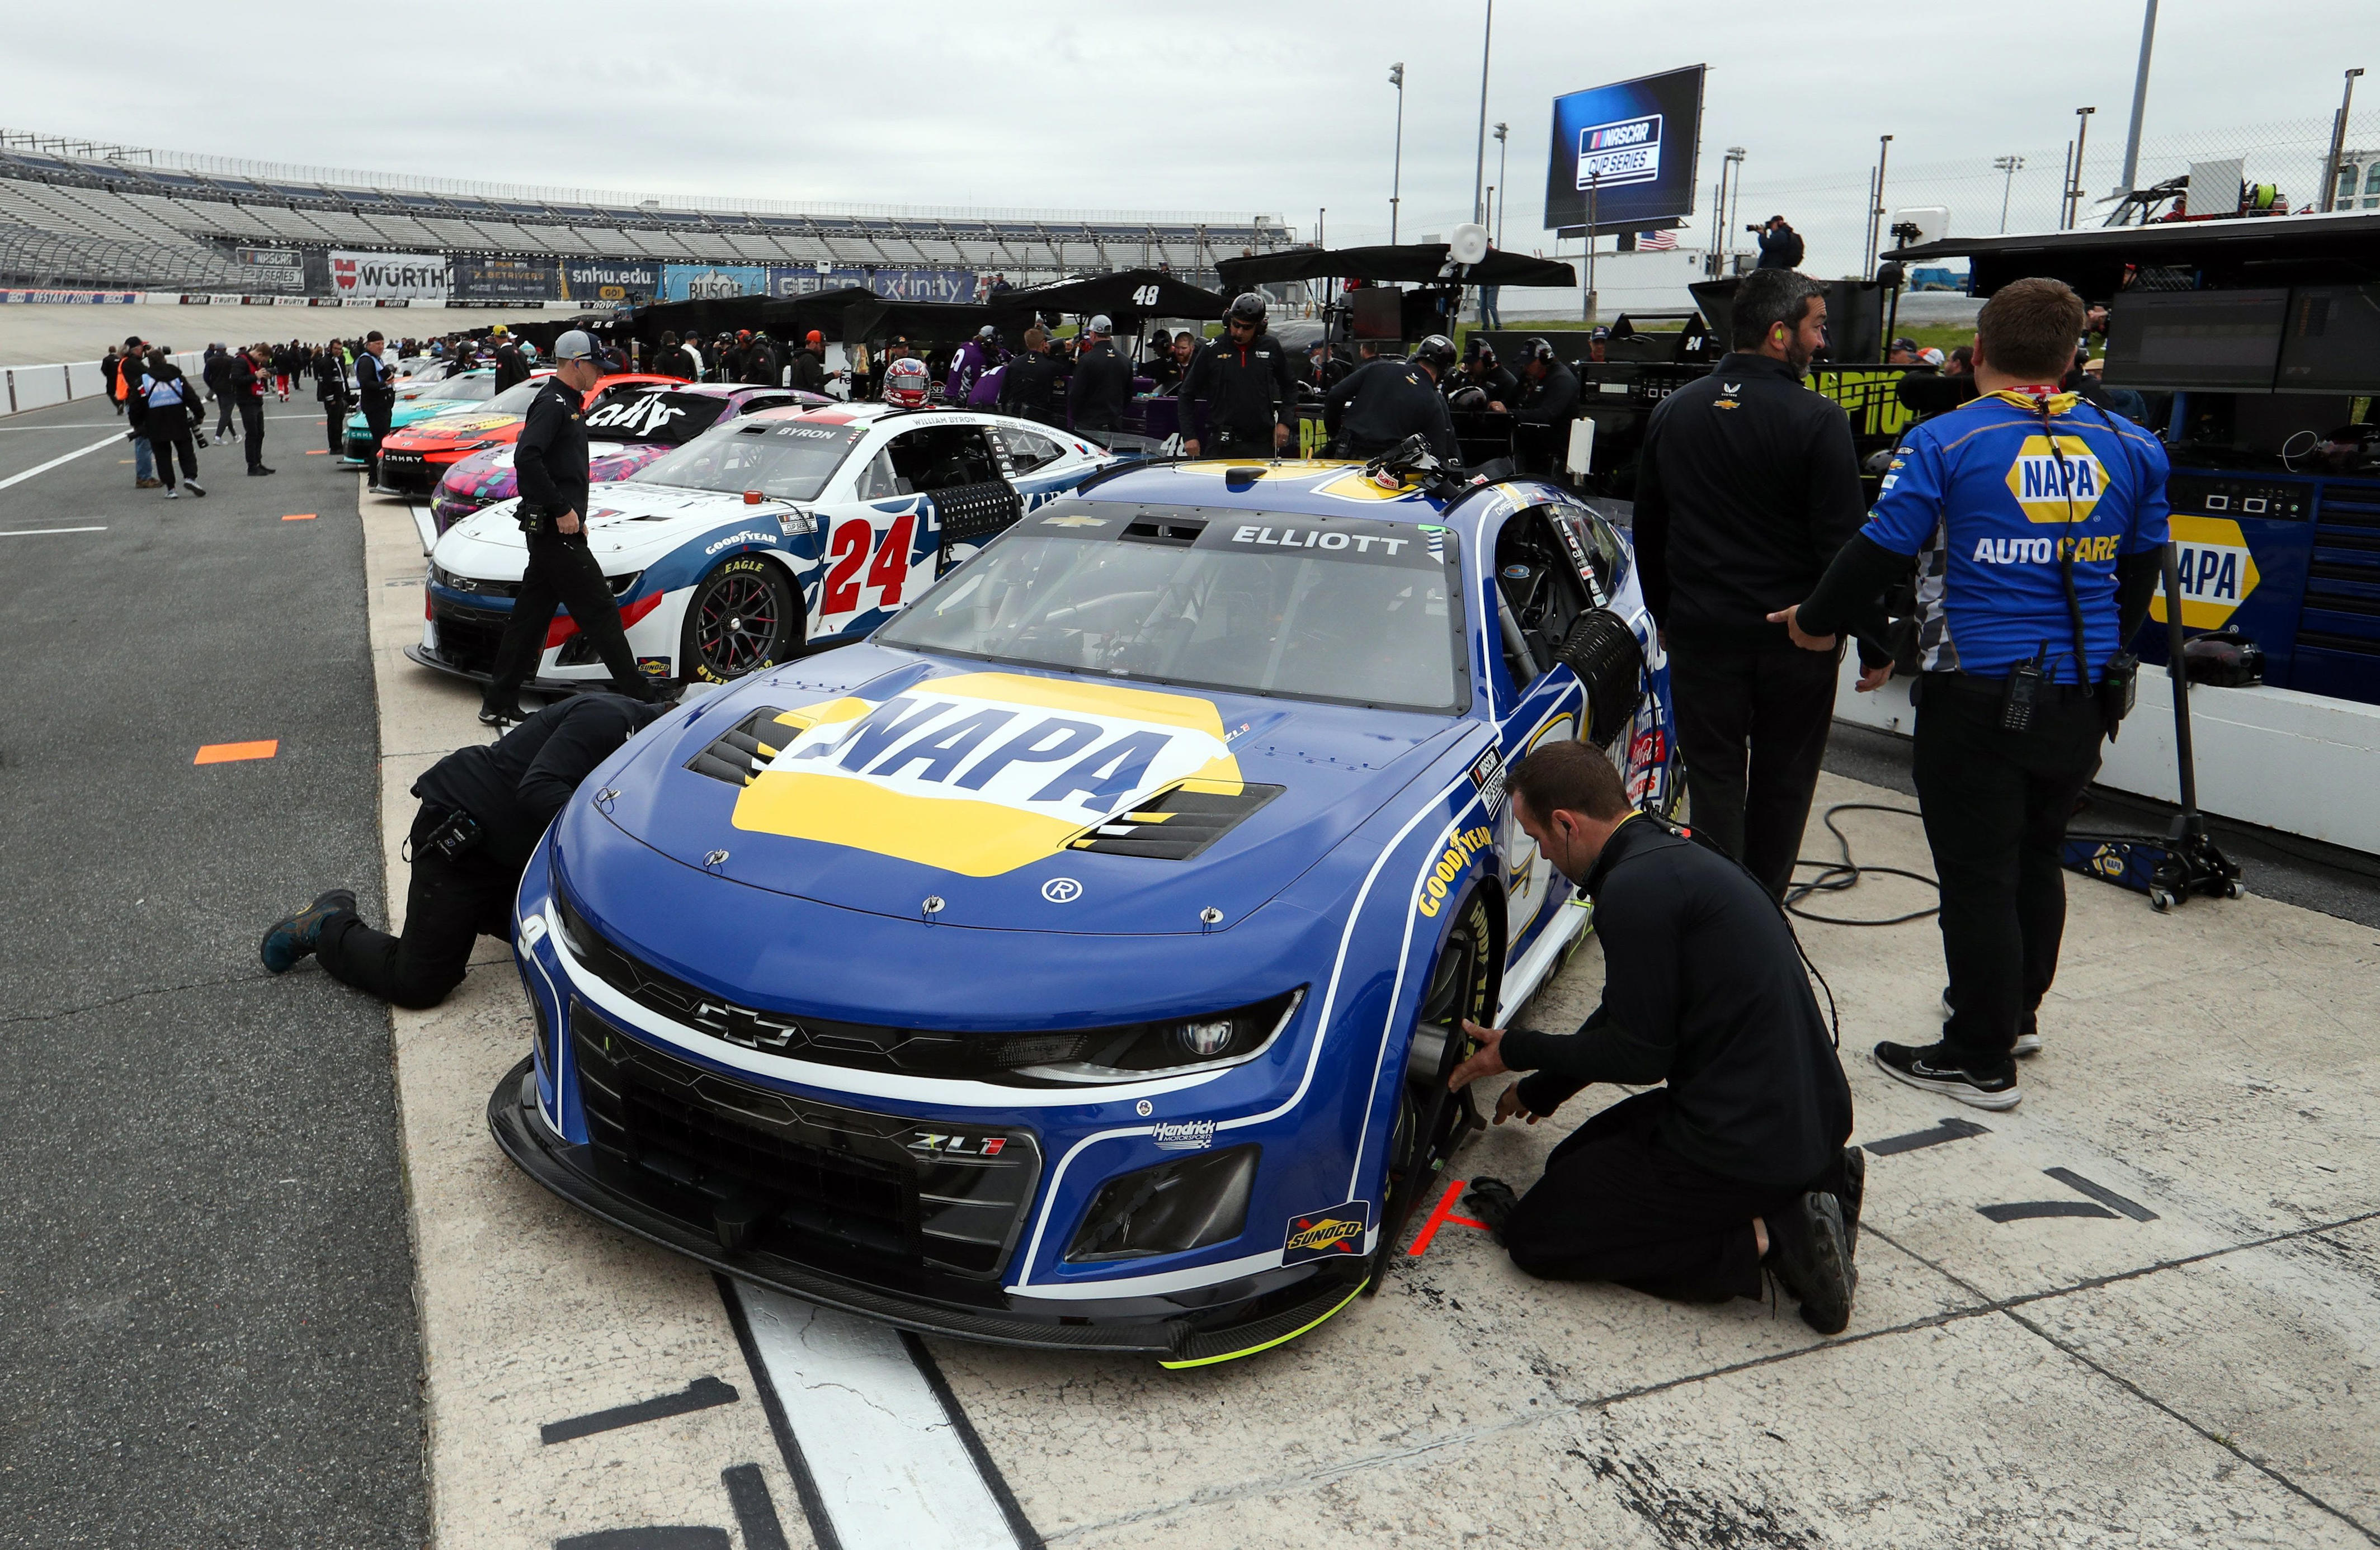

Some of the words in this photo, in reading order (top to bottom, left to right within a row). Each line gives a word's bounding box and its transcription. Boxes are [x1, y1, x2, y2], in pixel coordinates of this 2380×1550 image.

[1604, 122, 1650, 148] NASCAR
[1589, 159, 1609, 176] CUP
[1609, 151, 1648, 172] SERIES
[572, 267, 652, 284] snhu.edu
[779, 277, 860, 295] GEICO
[32, 291, 70, 304] RESTART
[70, 293, 95, 304] ZONE
[605, 289, 620, 297] GO!
[688, 282, 743, 300] BUSCH
[1132, 285, 1160, 306] 48
[1685, 335, 1703, 351] 24
[585, 392, 686, 436] ally
[1799, 370, 1914, 435] APTO
[776, 427, 837, 440] BYRON
[385, 454, 423, 464] CAMRY
[2024, 460, 2095, 498] NAPA
[1231, 525, 1410, 556] ELLIOTT
[1972, 537, 2052, 564] AUTO
[2057, 533, 2122, 563] CARE
[723, 559, 765, 574] EAGLE
[819, 514, 917, 616] 24
[2158, 548, 2236, 599] APA
[792, 697, 1174, 814] NAPA
[1478, 750, 1498, 779] NASCAR
[518, 914, 548, 962] 9
[1152, 1119, 1217, 1141] Hendrick
[1163, 1133, 1213, 1142] MOTORSPORTS
[906, 1131, 1007, 1156] ZL1
[1291, 1222, 1361, 1247] SUNOCO
